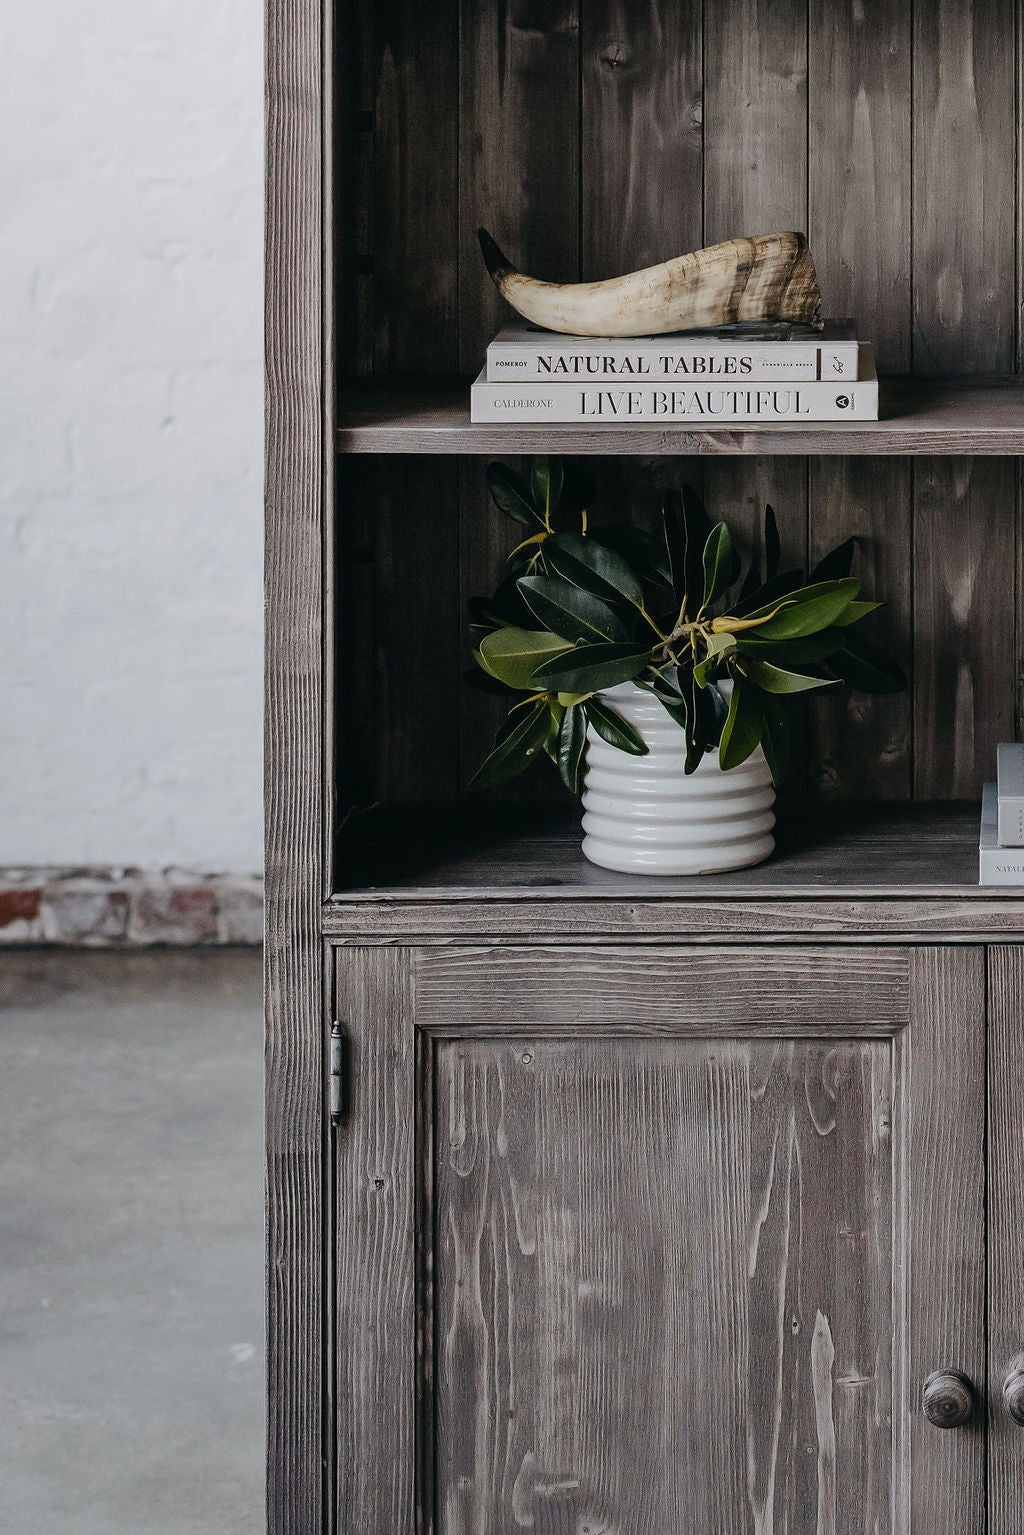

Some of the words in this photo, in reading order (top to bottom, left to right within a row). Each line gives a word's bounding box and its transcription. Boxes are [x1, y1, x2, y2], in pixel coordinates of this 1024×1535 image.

[536, 356, 650, 374] NATURAL
[659, 356, 752, 374] TABLES
[494, 399, 554, 409] CALDERONE
[579, 391, 643, 415] LIVE
[652, 390, 810, 414] BEAUTIFUL
